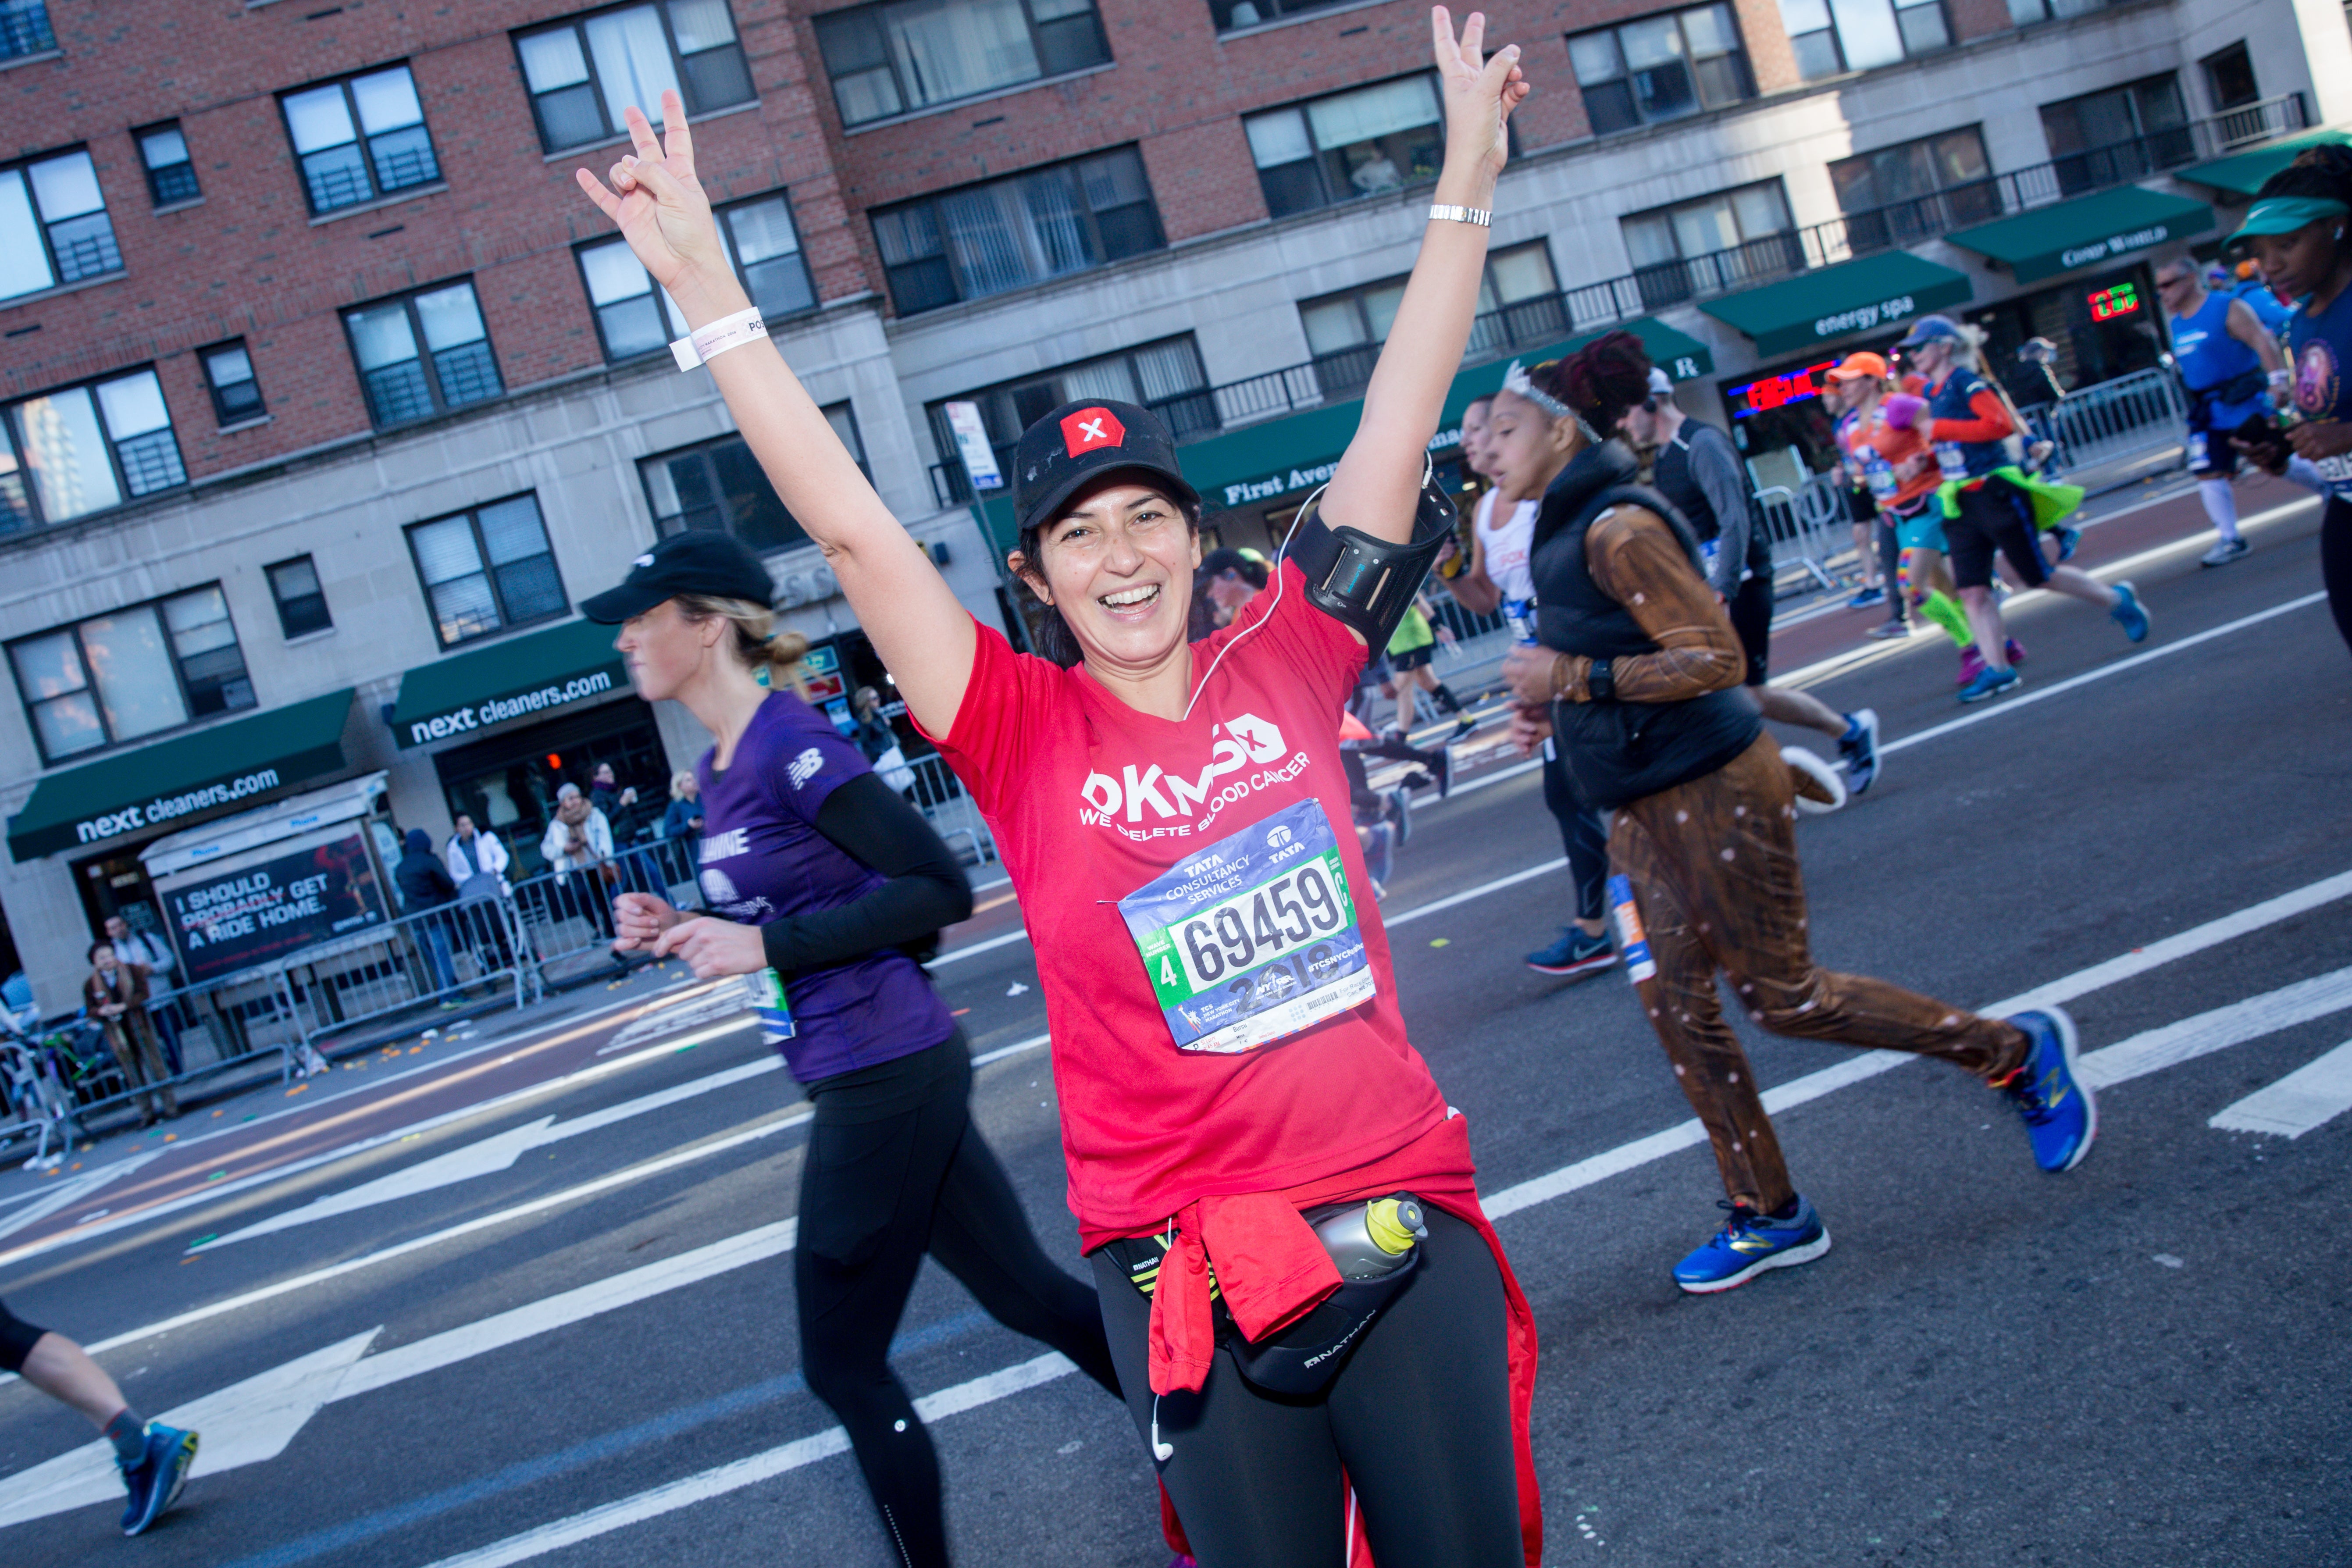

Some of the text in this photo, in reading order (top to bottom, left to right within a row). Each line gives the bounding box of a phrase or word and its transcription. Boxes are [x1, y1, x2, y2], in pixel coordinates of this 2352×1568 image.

[1815, 296, 1914, 336] energy spa
[705, 335, 726, 346] MARATHON
[1224, 475, 1284, 506] First
[1288, 461, 1339, 488] Aven
[411, 671, 611, 743] next cleaners.com
[77, 769, 279, 843] next cleaners.com
[1080, 752, 1310, 841] WE DELETE BLOOD CANCER
[1184, 854, 1223, 877] TATA
[1268, 842, 1305, 864] TATA
[1329, 856, 1338, 865] GREEN
[289, 873, 328, 899] GET
[1166, 855, 1250, 900] CONSULTANCY
[1187, 875, 1242, 904] SERVICES
[1335, 872, 1348, 907] C
[175, 873, 271, 913] I SHOULD
[189, 932, 205, 950] A
[206, 915, 257, 944] RIDE
[259, 896, 327, 928] HOME.
[1184, 868, 1339, 982] 69459
[1146, 943, 1171, 958] NUMBER
[1147, 940, 1165, 951] WAVE
[1161, 955, 1177, 987] 4
[1229, 944, 1339, 1016] 2018
[1201, 1004, 1213, 1012] TCS
[1203, 1009, 1215, 1018] NEW
[1215, 1003, 1229, 1012] YORK
[1205, 1008, 1232, 1023] MARATHON
[1233, 1023, 1247, 1032] Burcu
[1137, 1257, 1159, 1270] NATHAN
[1319, 1309, 1376, 1360] NATHAN
